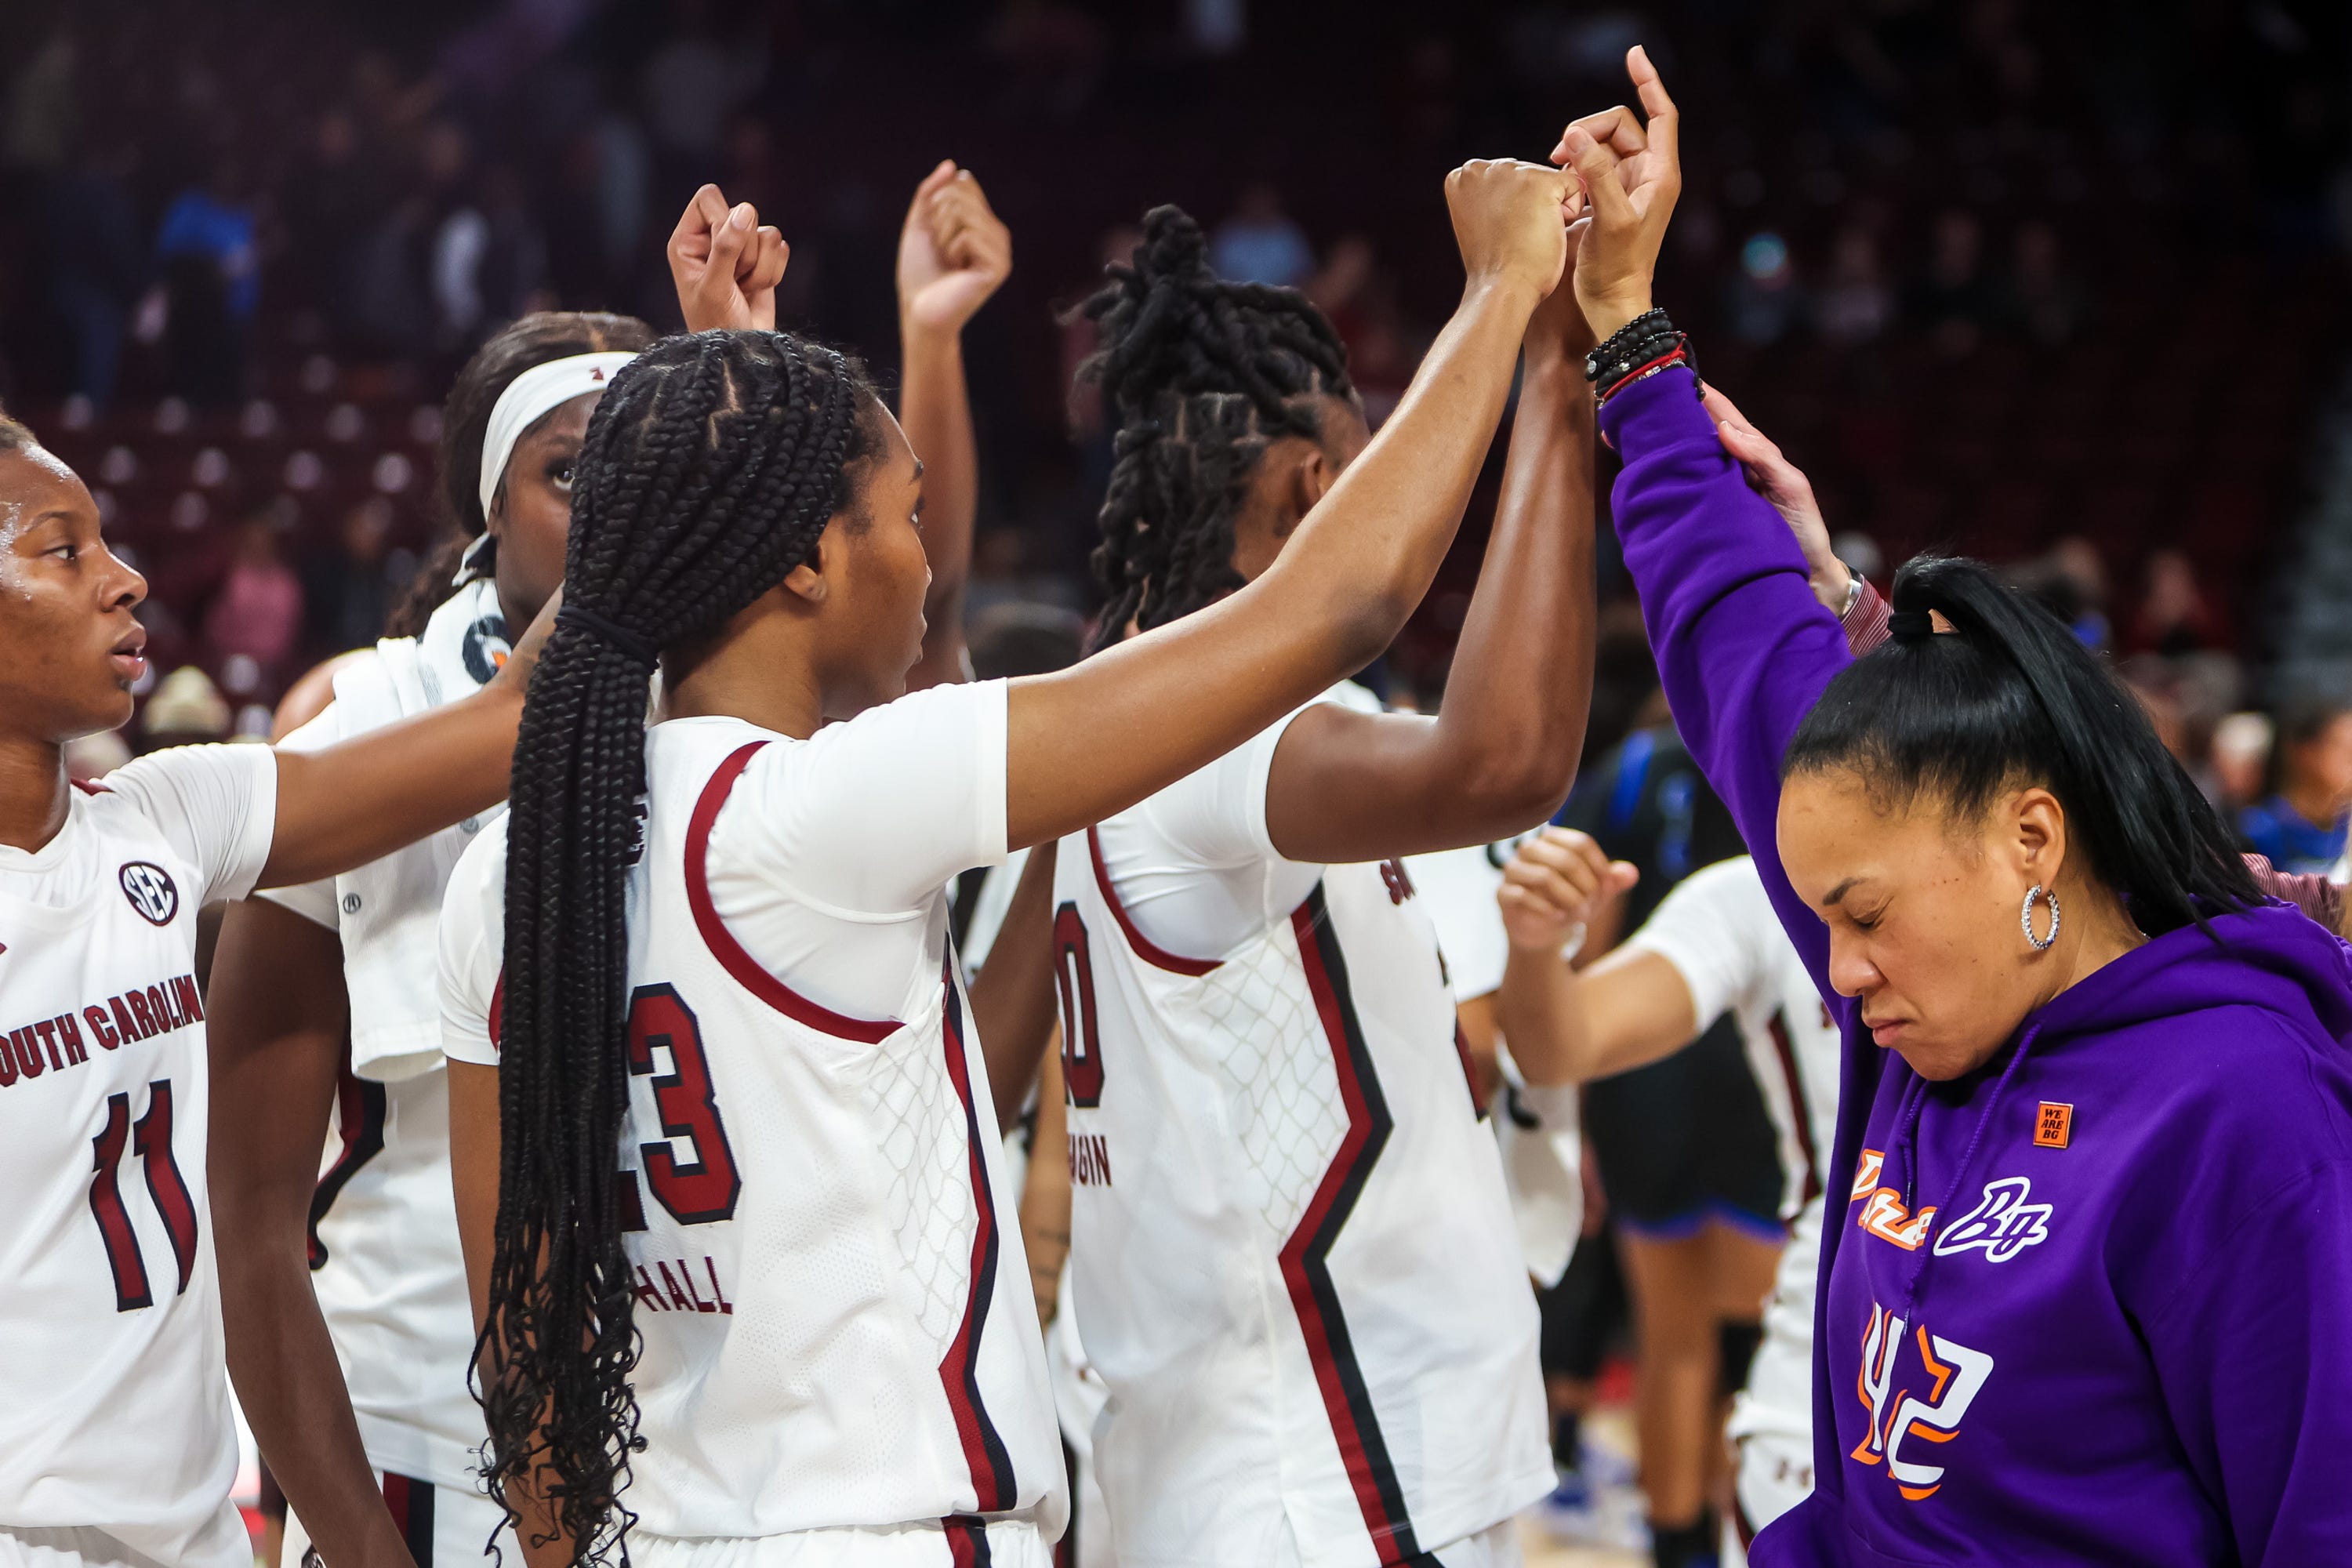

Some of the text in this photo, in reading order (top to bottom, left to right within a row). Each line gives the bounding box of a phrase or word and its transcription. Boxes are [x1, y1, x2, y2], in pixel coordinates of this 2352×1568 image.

[122, 864, 176, 923] SEC
[2045, 1109, 2063, 1119] WE
[2041, 1119, 2063, 1130] ARE
[2042, 1129, 2060, 1140] BG
[89, 1078, 198, 1312] 11
